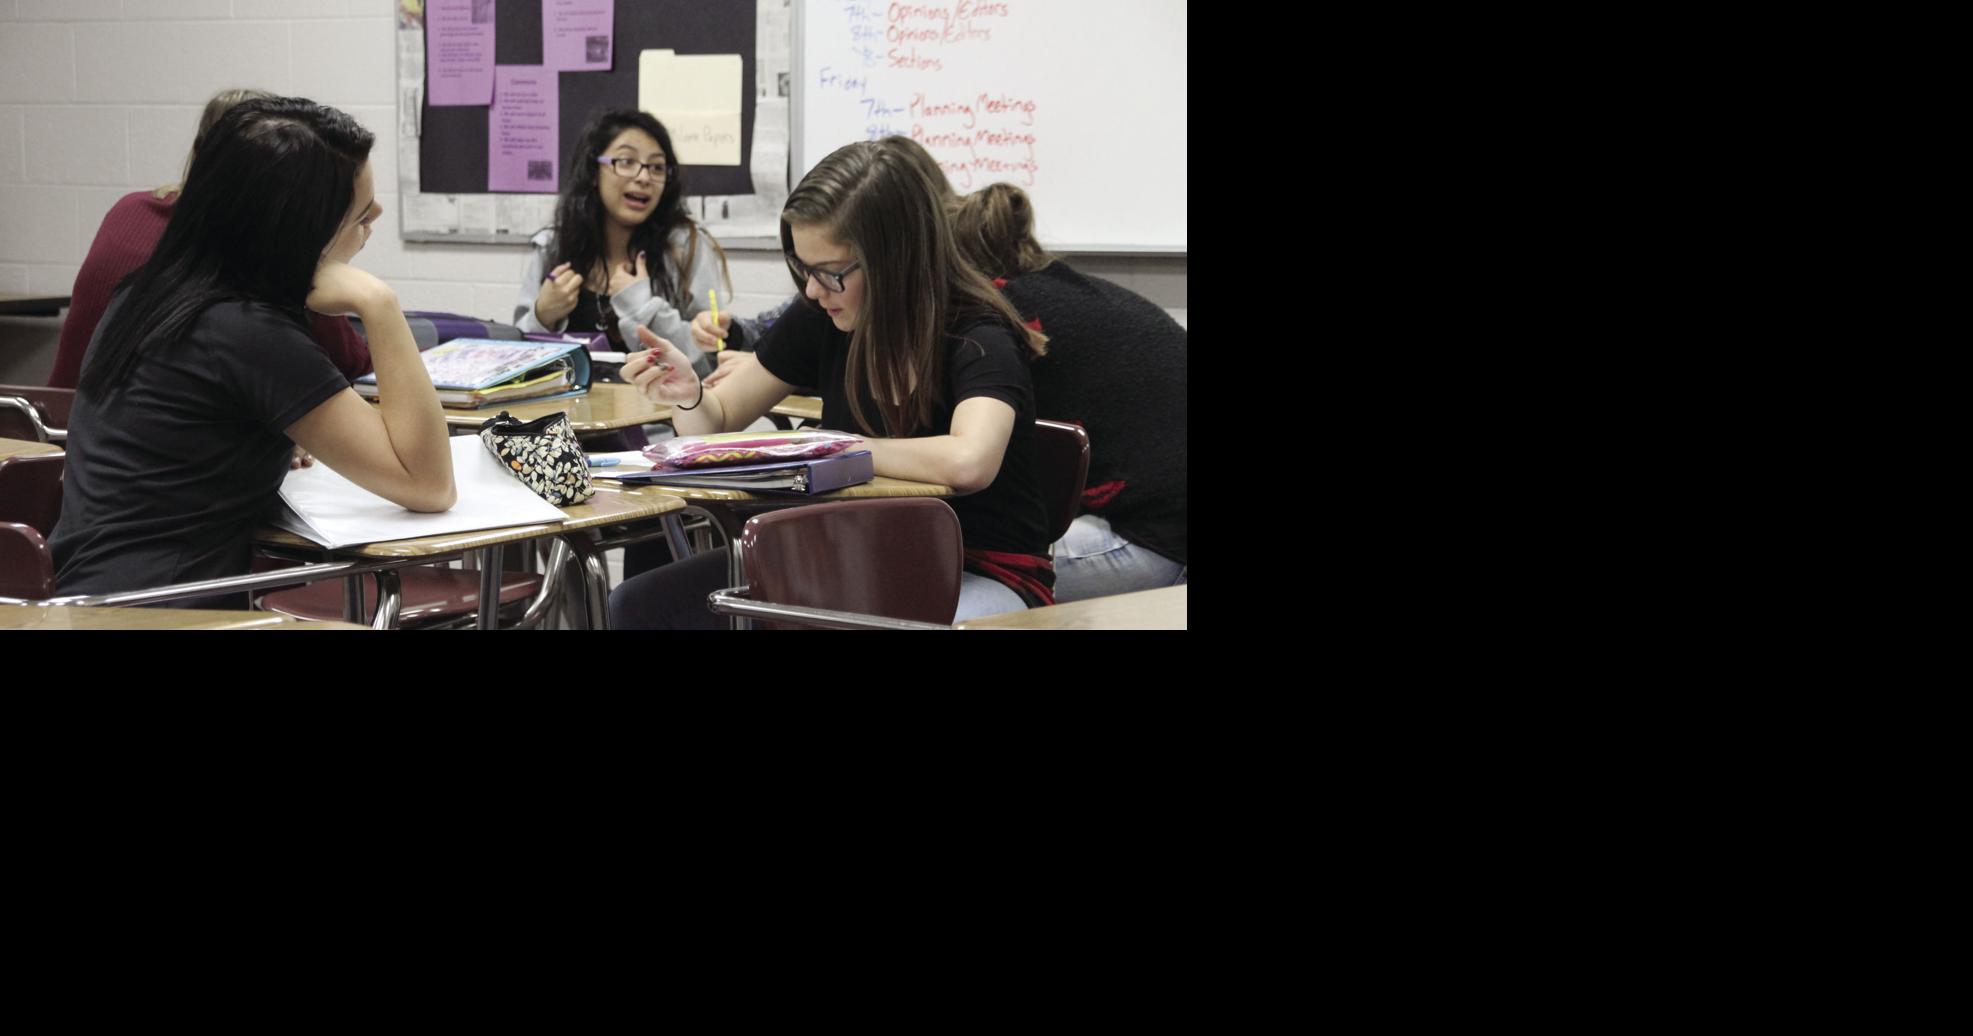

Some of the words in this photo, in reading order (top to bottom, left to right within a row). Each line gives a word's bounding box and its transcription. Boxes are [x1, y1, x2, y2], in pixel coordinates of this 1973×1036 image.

[886, 46, 943, 72] Sections
[819, 66, 868, 97] Friday
[909, 92, 977, 129] Planning
[975, 92, 1037, 127] Meetings
[911, 123, 977, 160] Planning
[974, 129, 1037, 160] Meetings
[972, 157, 1038, 187] Meetings
